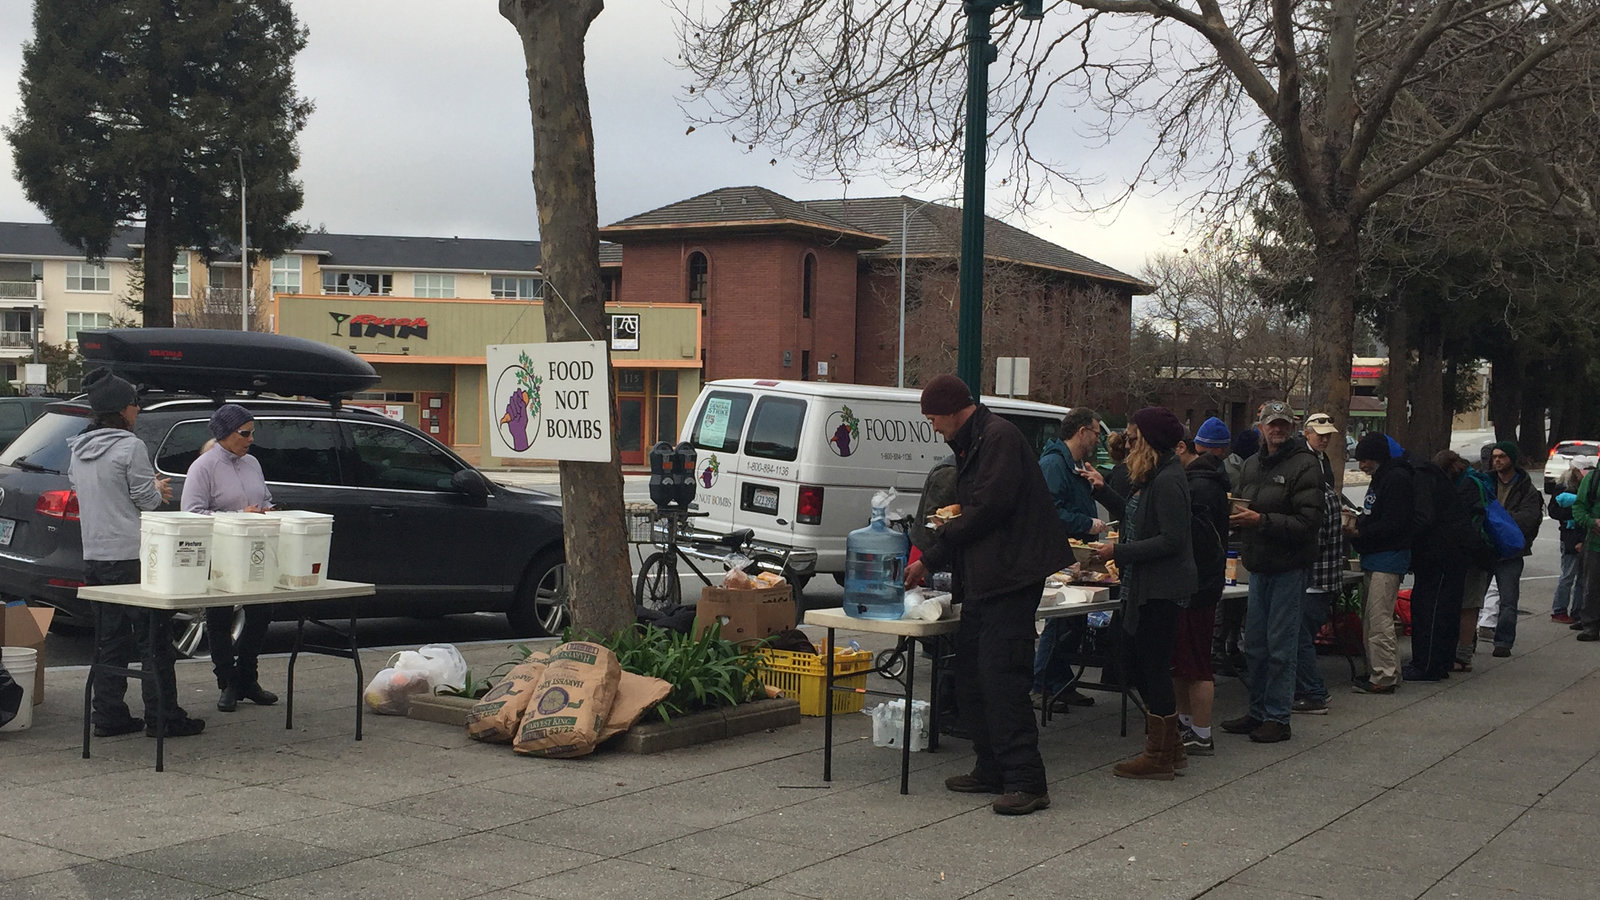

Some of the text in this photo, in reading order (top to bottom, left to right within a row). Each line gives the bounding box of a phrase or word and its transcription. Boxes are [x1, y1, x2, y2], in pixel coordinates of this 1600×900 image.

[349, 322, 428, 340] INN
[548, 361, 594, 381] FOOD
[554, 390, 589, 410] NOT
[546, 418, 602, 440] BOMBS
[864, 418, 907, 442] FOOD
[747, 461, 789, 477] 1-800-884-1136
[699, 494, 712, 504] NOT
[711, 495, 732, 508] BOMBS
